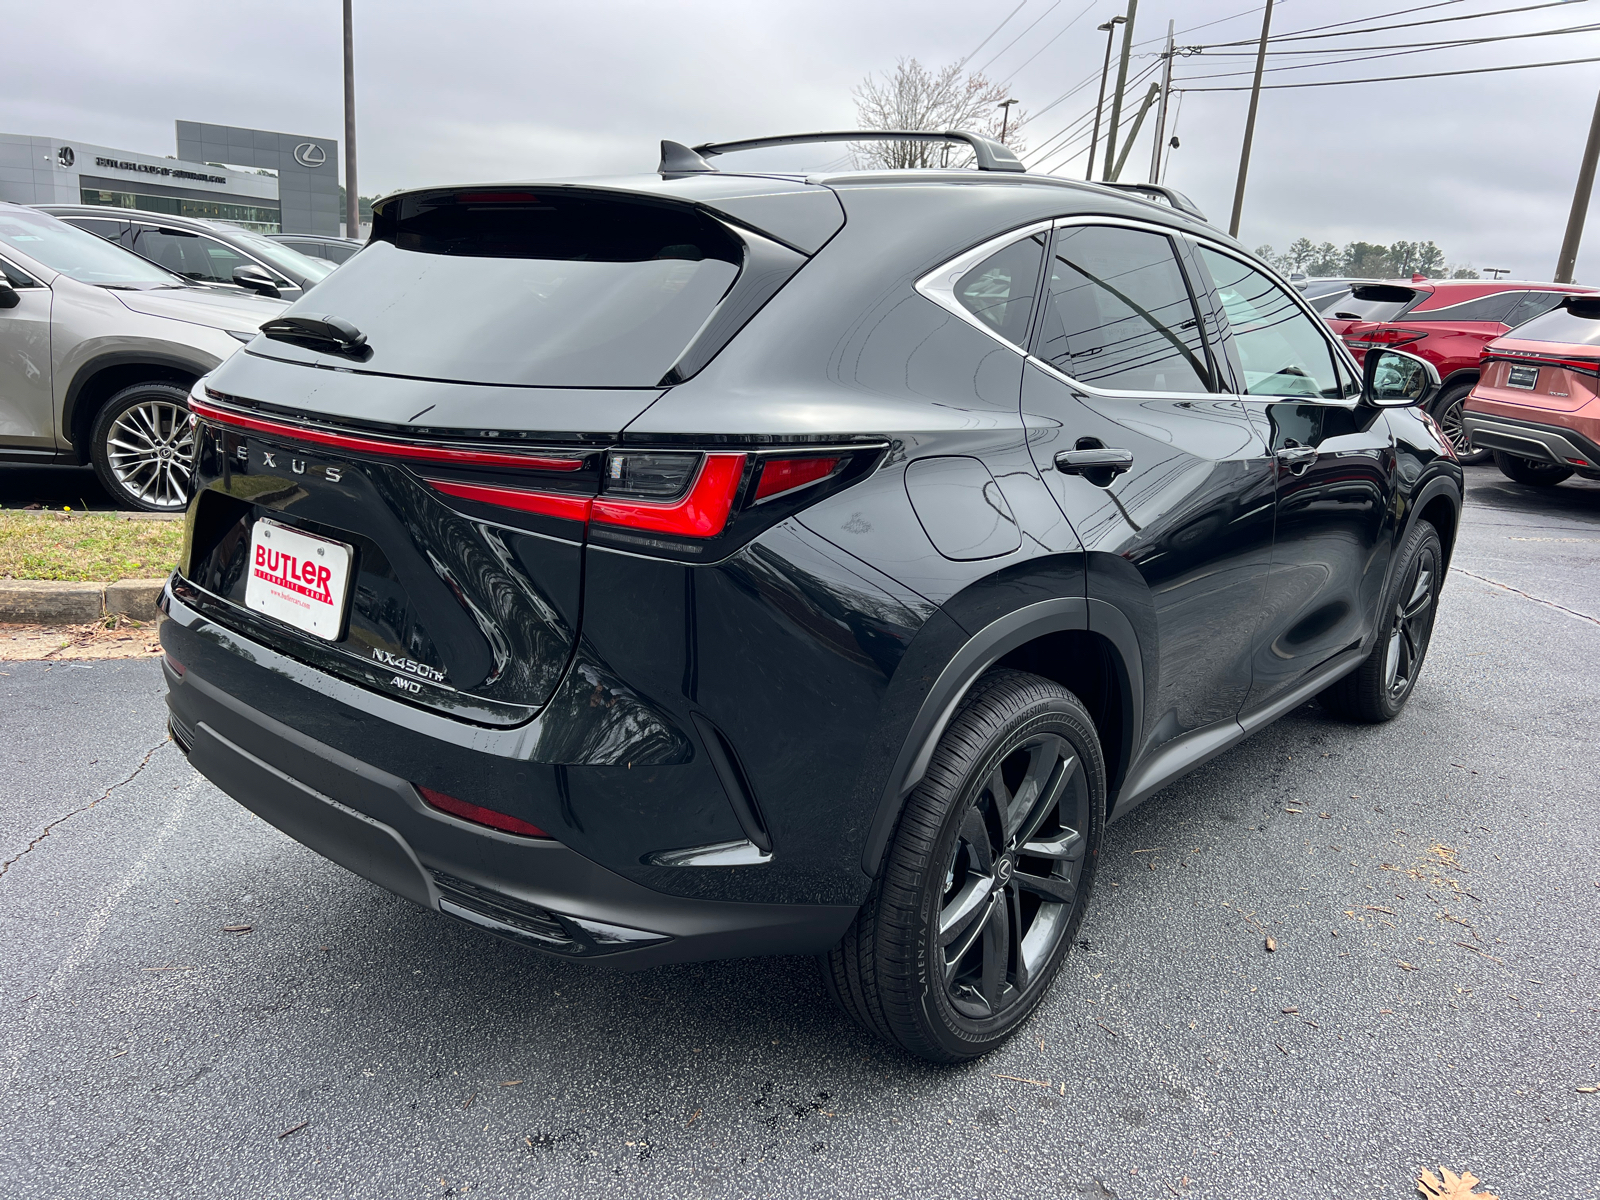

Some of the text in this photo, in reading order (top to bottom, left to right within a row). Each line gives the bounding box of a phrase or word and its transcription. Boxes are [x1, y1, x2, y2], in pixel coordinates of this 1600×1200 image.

[215, 439, 343, 483] LEXUS
[255, 544, 332, 594] BUTLER
[305, 589, 331, 604] GROUP
[390, 676, 421, 694] AWD
[917, 927, 927, 984] ALENZA
